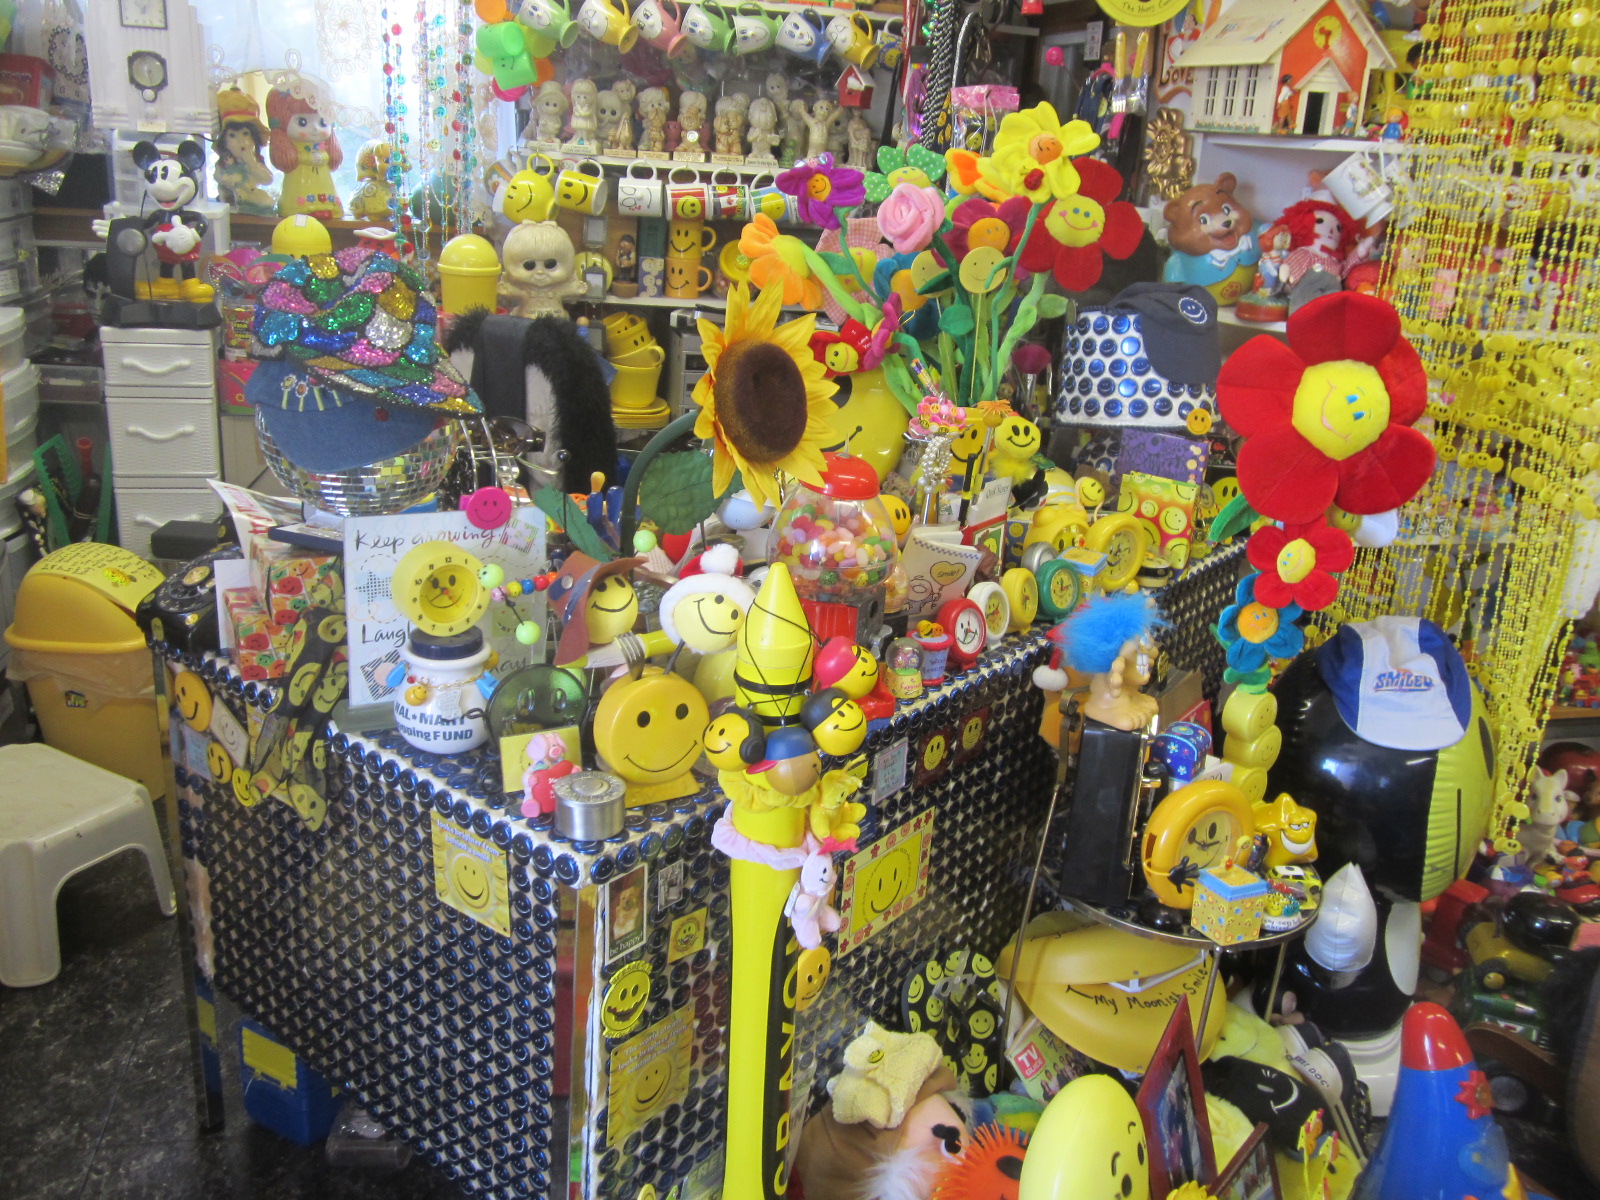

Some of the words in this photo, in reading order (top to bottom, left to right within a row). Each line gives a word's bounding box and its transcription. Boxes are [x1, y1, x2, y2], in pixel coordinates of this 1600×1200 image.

[355, 530, 405, 554] Keep
[433, 729, 473, 741] FUND
[1094, 995, 1118, 1015] My
[1126, 992, 1182, 1010] Moonish
[1183, 969, 1208, 995] Smile
[1018, 1045, 1038, 1067] TV
[1025, 1058, 1044, 1076] GUIDE
